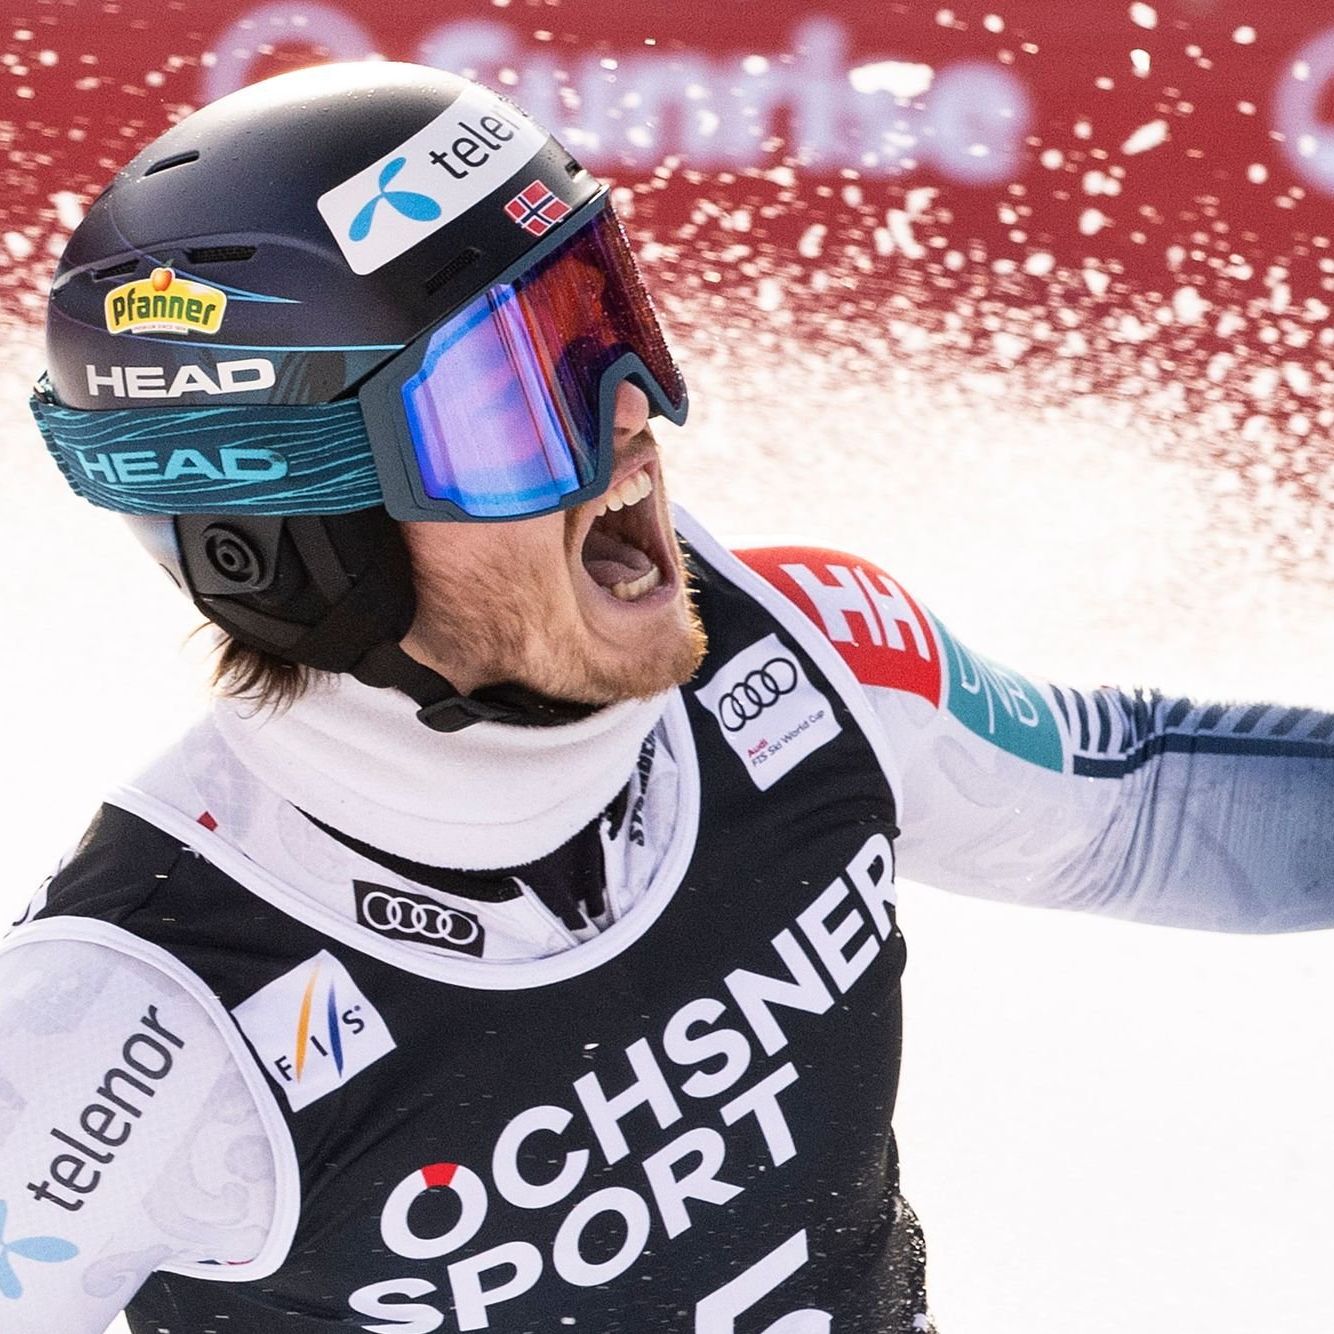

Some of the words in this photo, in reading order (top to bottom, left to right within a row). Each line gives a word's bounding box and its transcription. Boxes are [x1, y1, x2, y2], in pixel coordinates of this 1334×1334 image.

[86, 358, 276, 398] HEAD
[78, 448, 288, 484] HEAD
[780, 563, 930, 661] HH
[747, 738, 768, 757] Audi
[752, 751, 768, 767] FIS
[780, 720, 810, 744] World
[380, 833, 896, 1260] OCHSNER
[26, 1005, 186, 1213] telenor
